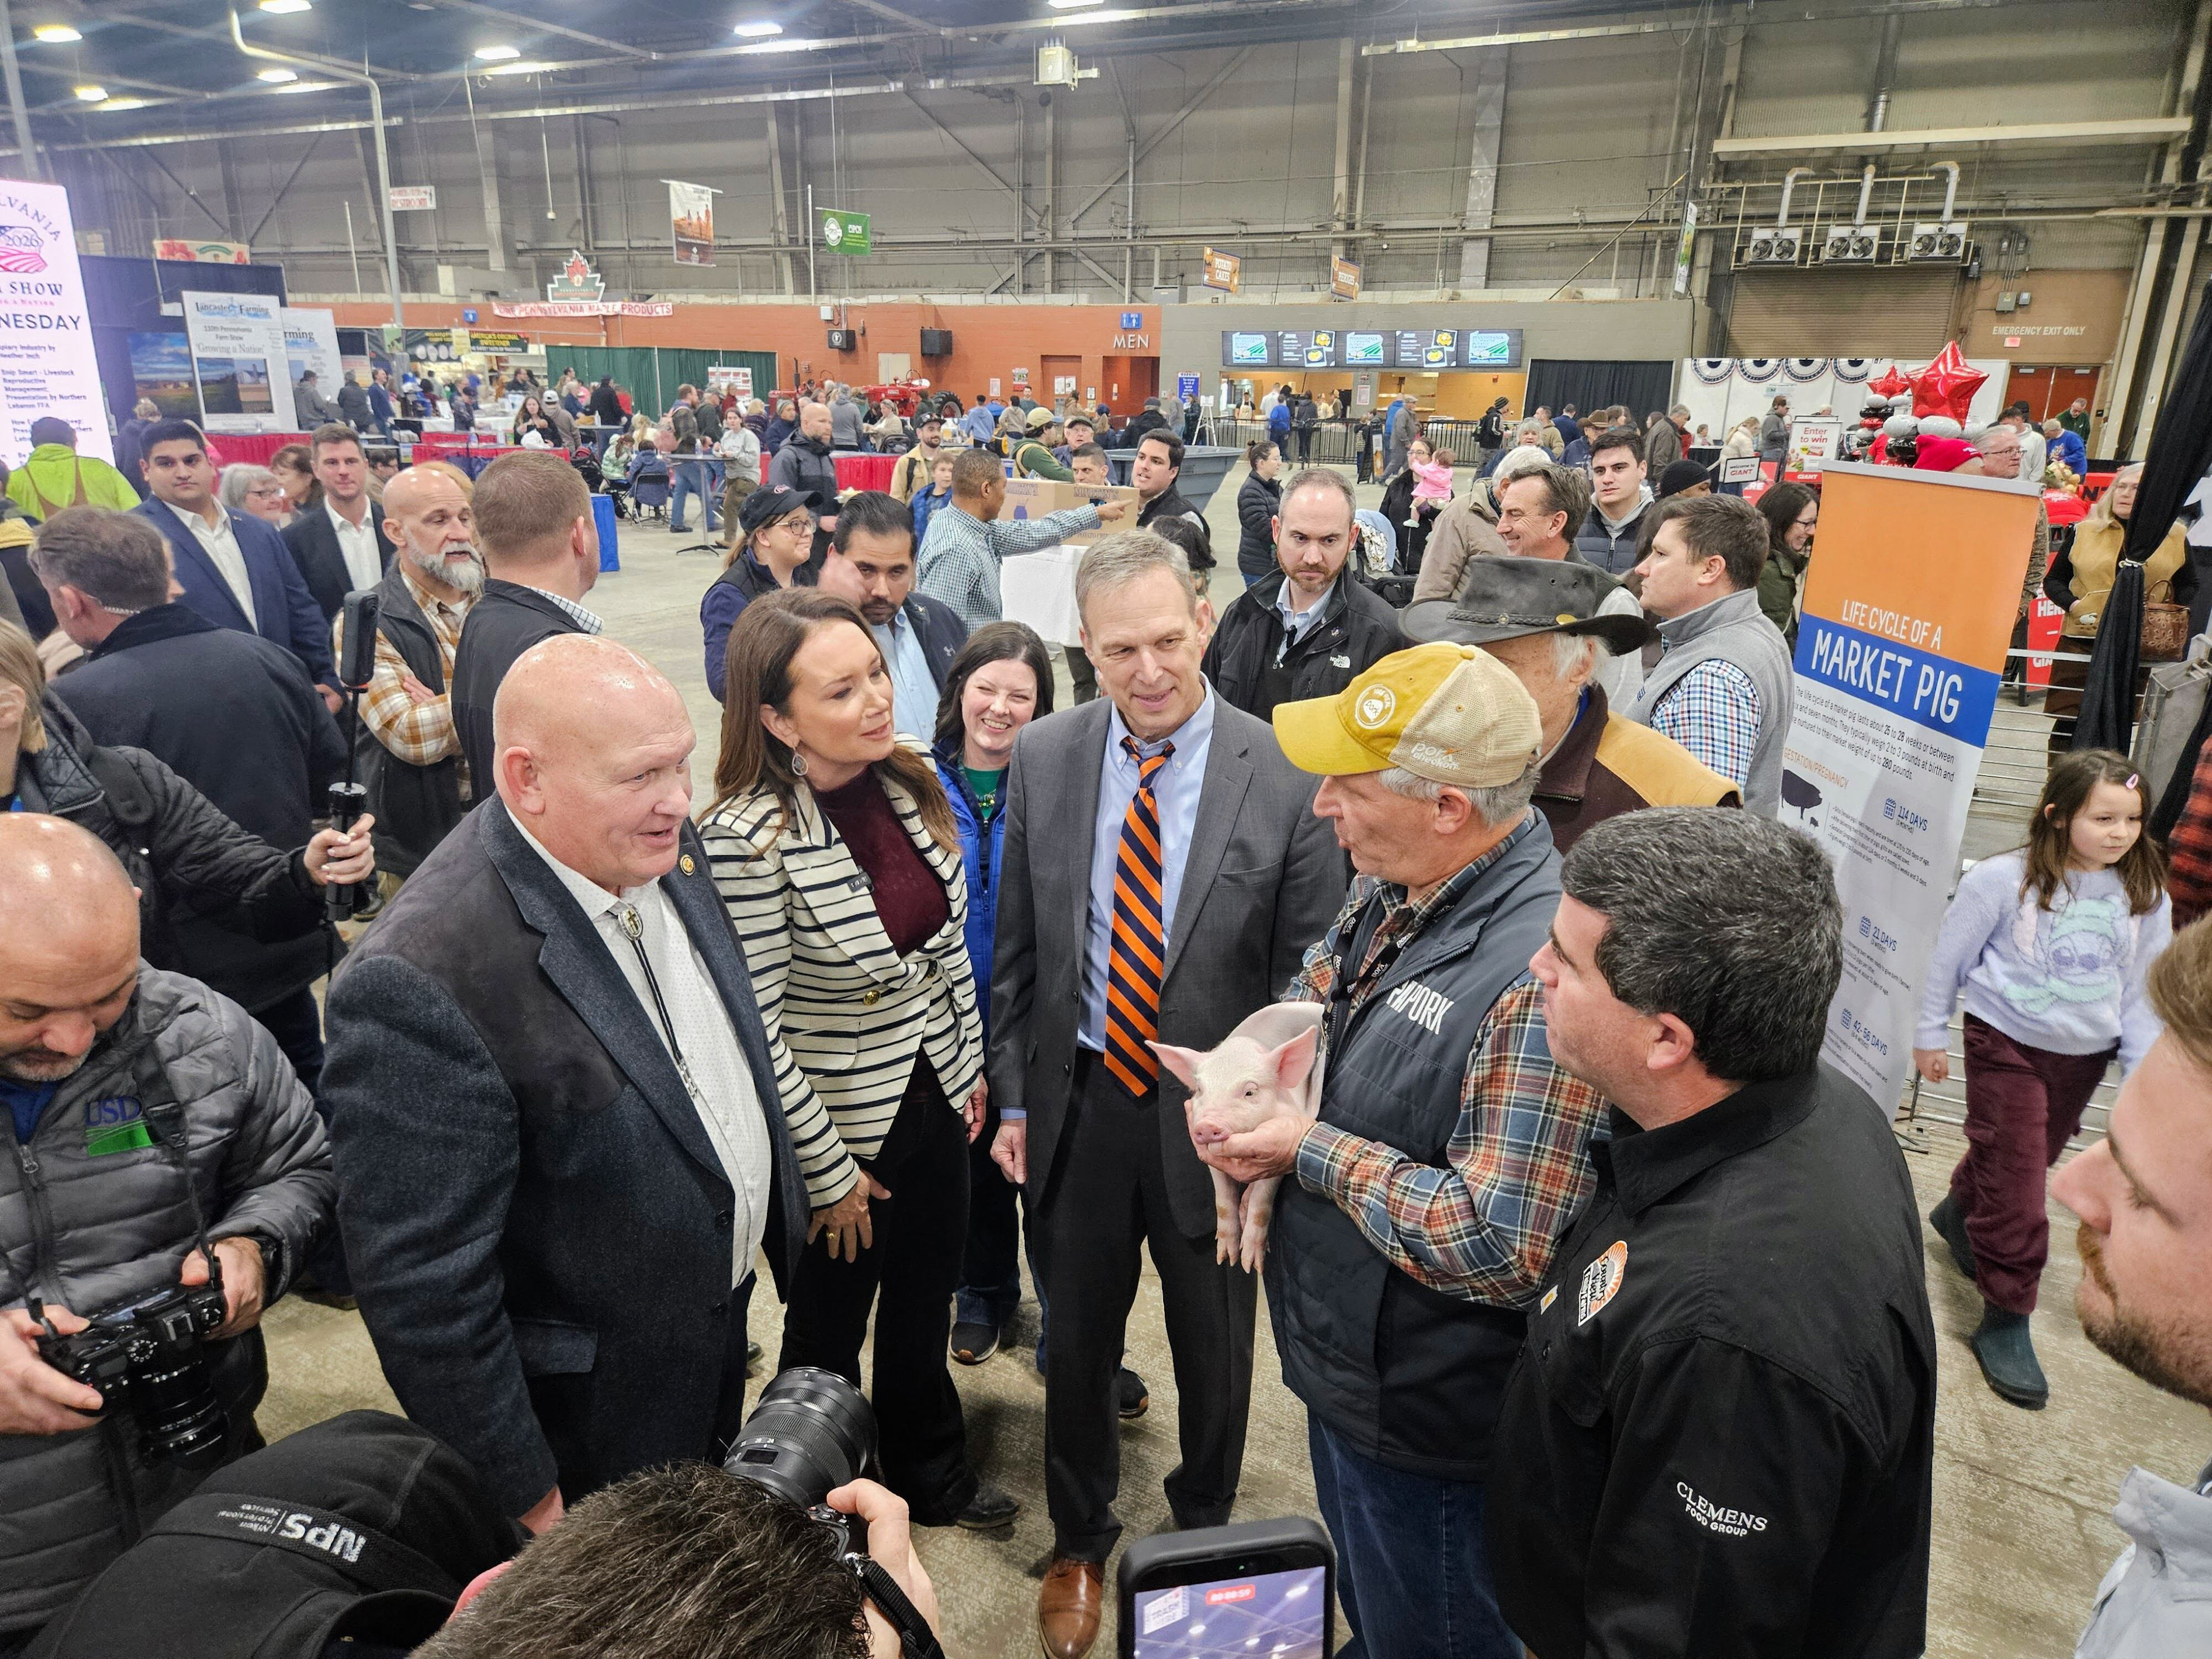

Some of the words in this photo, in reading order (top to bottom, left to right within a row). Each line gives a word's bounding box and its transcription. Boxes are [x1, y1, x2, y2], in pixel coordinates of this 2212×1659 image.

[1215, 258, 1232, 271] POTATO
[1216, 269, 1230, 282] CAKES
[9, 281, 63, 296] SHOW
[240, 304, 270, 314] Farming
[519, 303, 585, 316] PENNSYLVANIA
[621, 303, 672, 315] PRODUCTS
[284, 327, 315, 342] rming
[1114, 334, 1150, 349] MEN
[1992, 326, 2042, 335] EMERGENCY
[2042, 326, 2063, 335] EXIT
[2063, 326, 2086, 336] ONLY
[1073, 486, 1120, 500] MARTIN'S
[1842, 599, 1868, 626] LIFE
[1868, 607, 1910, 640] CYCLE
[1911, 619, 1931, 645] OF
[1930, 625, 1942, 650] A
[1811, 629, 1913, 703] MARKET
[1914, 664, 1962, 724] PIG
[1848, 711, 1857, 722] pig
[1869, 719, 1883, 732] about
[1891, 728, 1896, 739] to
[1897, 730, 1905, 741] 28
[1905, 736, 1922, 750] weeks
[1922, 744, 1929, 752] or
[1929, 744, 1954, 764] between
[1839, 720, 1849, 735] They
[1850, 726, 1871, 745] typically
[1871, 737, 1885, 751] weigh
[1886, 741, 1890, 752] 2
[1890, 745, 1896, 755] to
[1897, 746, 1901, 757] 3
[1901, 751, 1921, 766] pounds
[1921, 760, 1927, 770] at
[1927, 761, 1942, 777] birth
[1943, 770, 1954, 782] and
[1848, 742, 1864, 756] weight
[1864, 749, 1871, 758] of
[1870, 753, 1876, 762] up
[1882, 756, 1892, 769] 280
[1897, 806, 1909, 821] 114
[1909, 812, 1927, 831] DAYS
[1872, 926, 1880, 940] 21
[1879, 931, 1897, 951] DAYS
[1397, 984, 1455, 1035] PORK
[1863, 1028, 1871, 1041] 56
[1871, 1035, 1887, 1055] DAYS
[86, 1096, 143, 1126] USD
[1589, 1272, 1600, 1302] View
[1598, 1256, 1609, 1301] Country
[218, 1510, 276, 1525] Professional
[240, 1503, 281, 1516] Services
[1676, 1482, 1768, 1531] CLEMENS
[239, 1521, 272, 1533] Nikon
[1685, 1503, 1708, 1526] FOOD
[1710, 1521, 1748, 1537] GROUP
[279, 1513, 368, 1562] NPS
